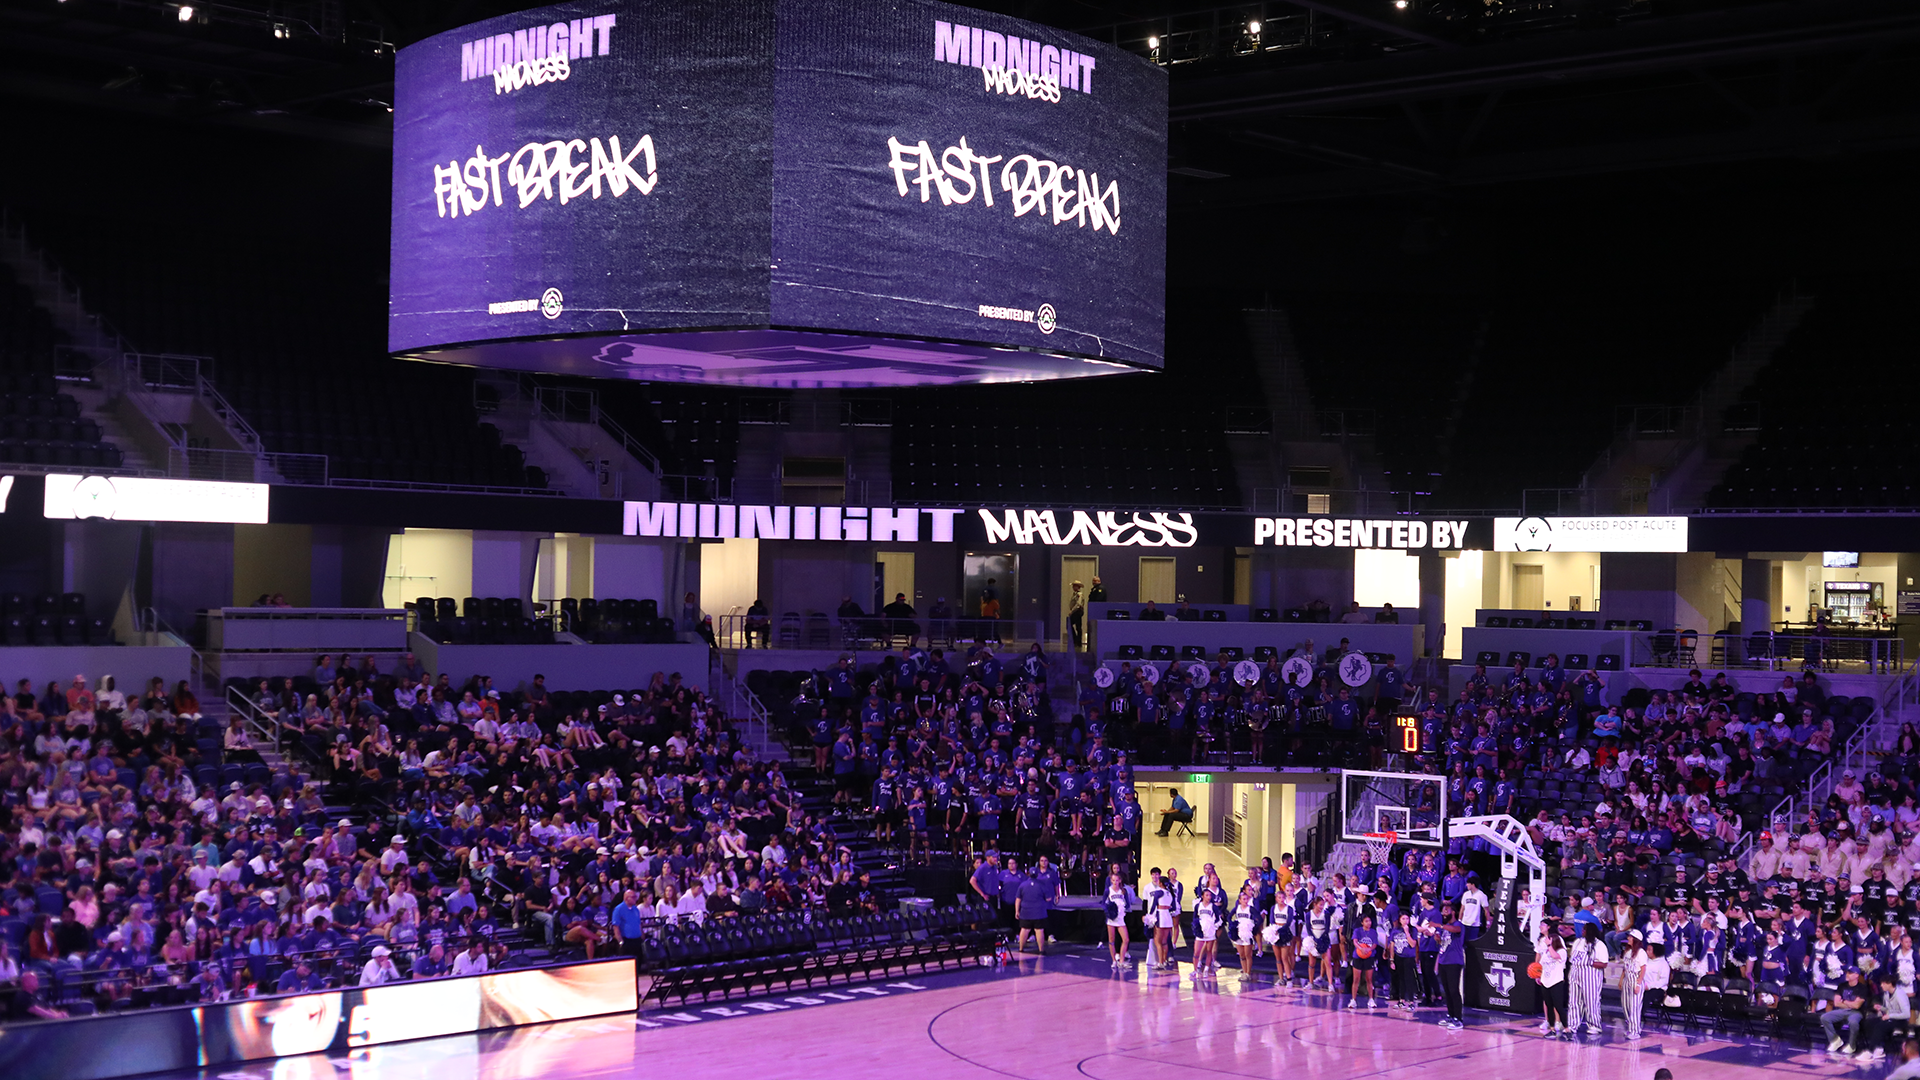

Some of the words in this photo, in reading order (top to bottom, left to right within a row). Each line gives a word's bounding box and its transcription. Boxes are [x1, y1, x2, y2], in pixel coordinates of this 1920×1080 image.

[461, 13, 616, 82] MIDNIGHT
[935, 20, 1096, 94] MIDNIGHT
[493, 50, 570, 95] MADNESS
[981, 63, 1061, 103] MADNESS
[434, 144, 511, 219] FAST
[887, 135, 1002, 207] FAST
[978, 304, 1024, 322] PRESENTED
[1023, 310, 1035, 323] BY
[623, 500, 965, 542] MIDNIGHT
[978, 508, 1198, 547] MADNESS
[1254, 517, 1427, 548] PRESENTED
[1432, 520, 1469, 548] BY
[1562, 520, 1609, 530] FOCUSED
[1613, 520, 1639, 530] POST
[1642, 520, 1677, 530] ACUTE
[1404, 727, 1418, 752] 0
[1497, 879, 1511, 946] TEXANS
[1483, 951, 1518, 963] TARLETON
[1488, 996, 1511, 1007] STATE
